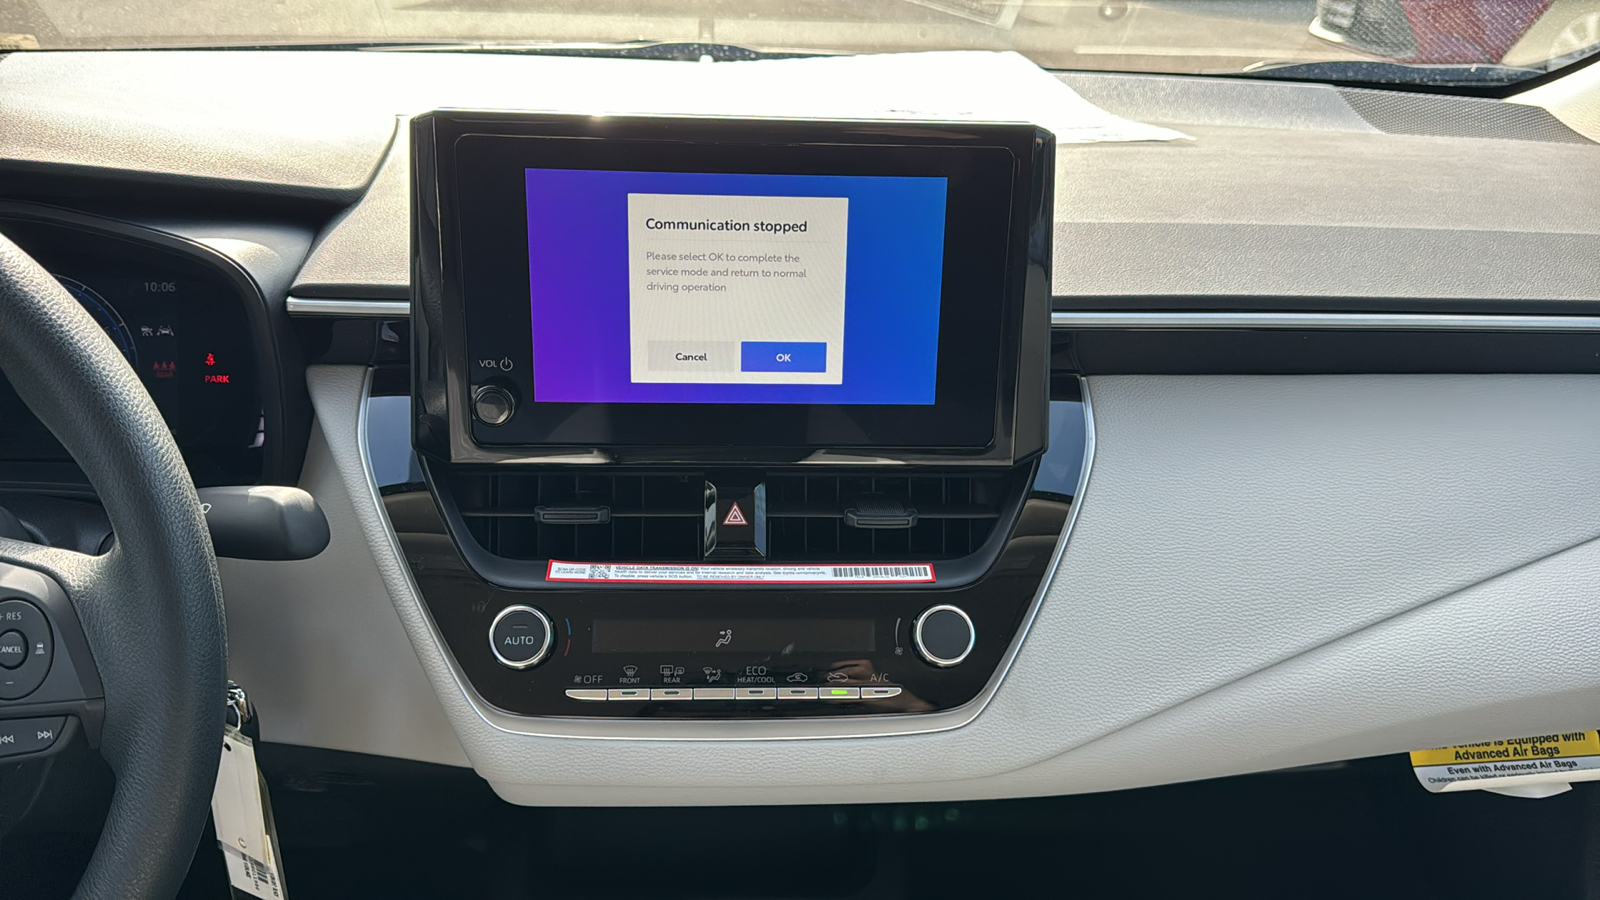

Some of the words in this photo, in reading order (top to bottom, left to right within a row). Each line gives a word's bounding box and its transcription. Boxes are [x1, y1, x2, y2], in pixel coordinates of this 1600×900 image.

[646, 218, 750, 232] Communication
[753, 220, 808, 234] stopped
[646, 252, 677, 261] Please
[679, 252, 706, 262] select
[708, 253, 724, 262] OK
[726, 254, 736, 262] to
[738, 254, 782, 264] complete
[784, 254, 800, 262] the
[646, 267, 678, 276] service
[681, 268, 708, 276] mode
[710, 268, 728, 277] and
[731, 269, 759, 277] return
[762, 269, 772, 277] to
[773, 269, 807, 278] normal
[144, 282, 176, 292] 10:06
[646, 282, 679, 293] driving
[681, 283, 726, 294] operation
[675, 353, 707, 361] Cancel
[776, 354, 791, 362] OK
[479, 360, 498, 368] VOL
[204, 375, 230, 384] PARK
[6, 612, 21, 620] RES
[504, 636, 534, 645] AUTO
[746, 666, 766, 676] ECO
[583, 675, 603, 684] OFF
[870, 672, 889, 683] A/C
[1507, 734, 1559, 746] Equipped
[1562, 732, 1586, 742] with
[1454, 748, 1510, 760] Advanced
[1513, 746, 1528, 757] Air
[1531, 746, 1560, 757] Bags
[1494, 762, 1538, 771] Advanced
[1553, 760, 1578, 768] Bags
